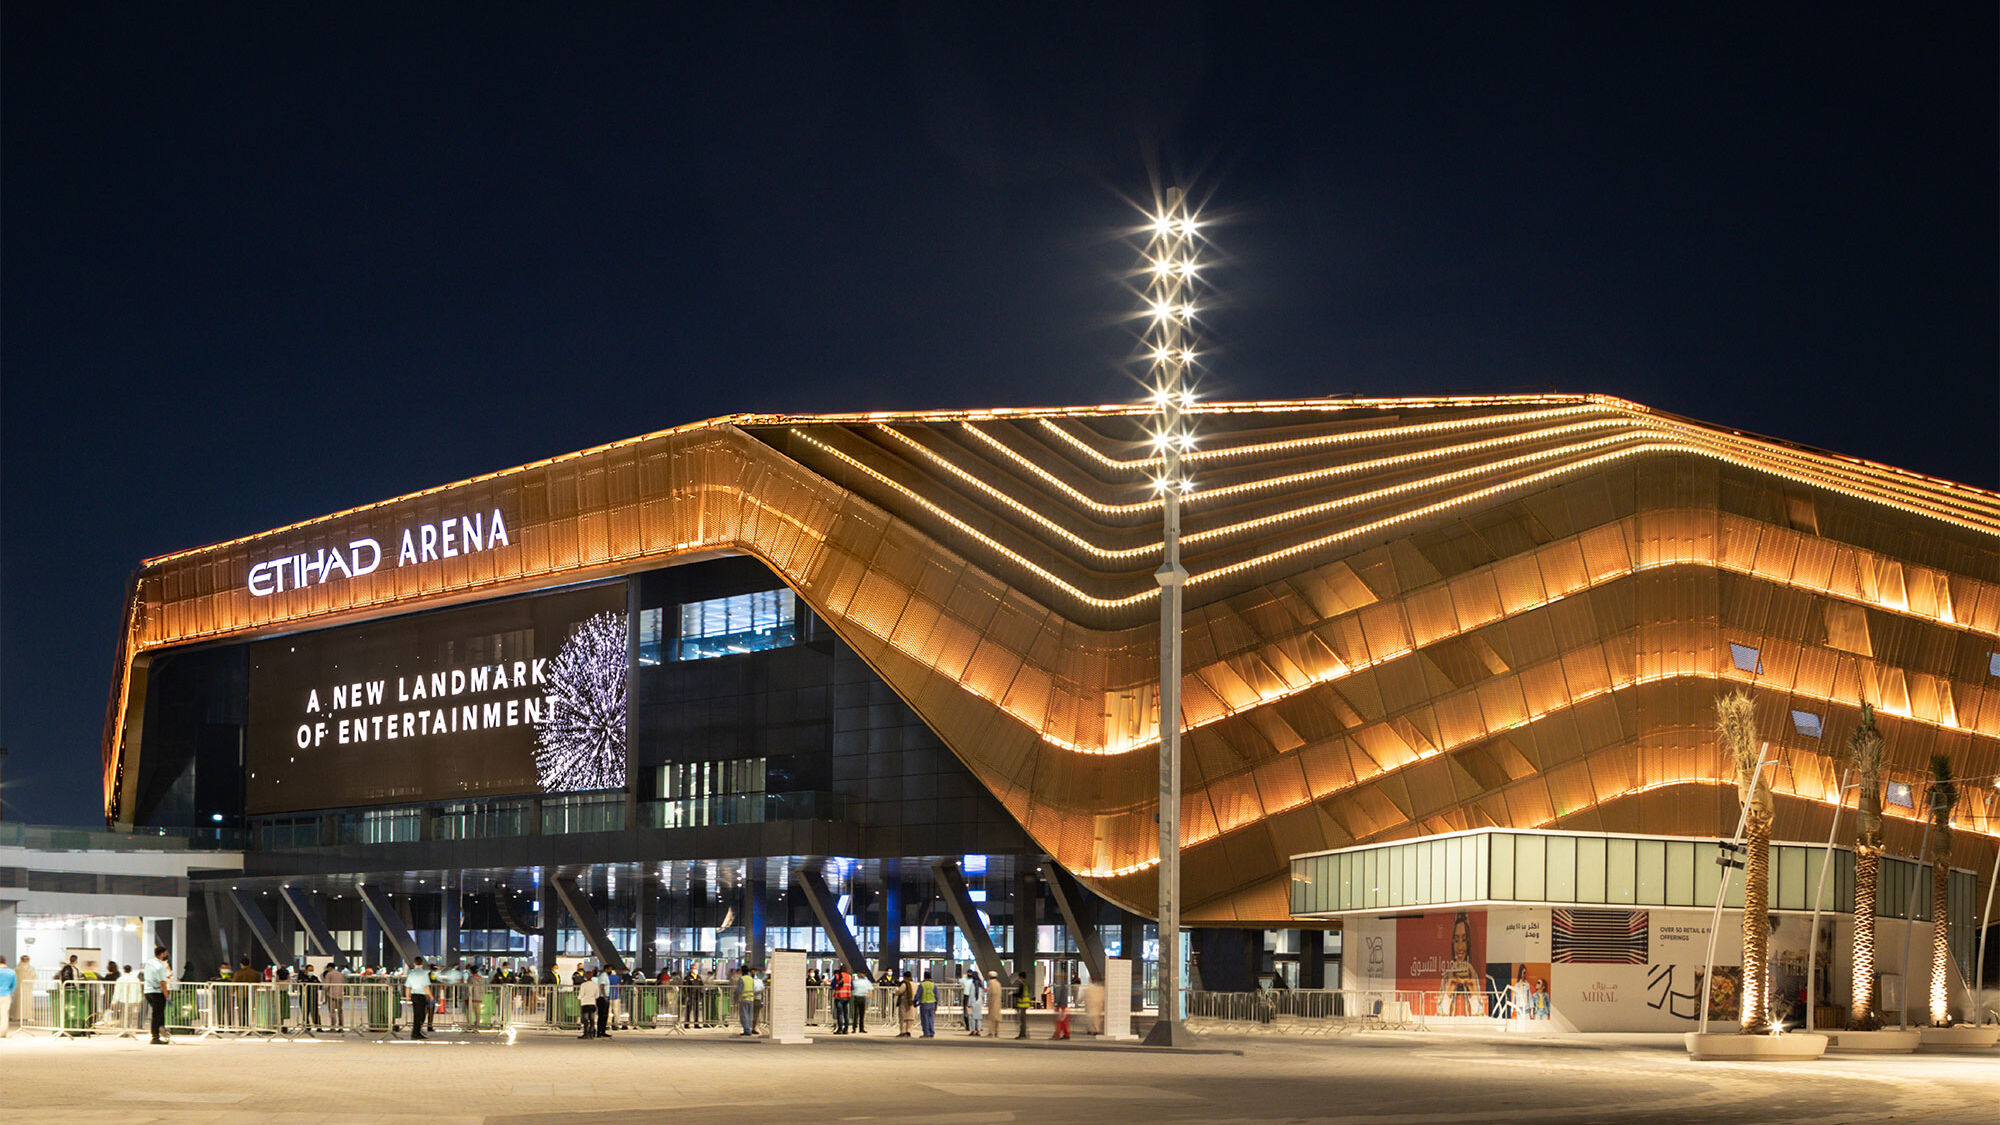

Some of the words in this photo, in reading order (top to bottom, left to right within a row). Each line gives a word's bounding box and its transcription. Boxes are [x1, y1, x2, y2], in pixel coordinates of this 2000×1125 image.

[248, 538, 381, 597] ETIHAD
[398, 508, 509, 568] ARENA
[306, 689, 320, 714] A
[333, 680, 385, 710] NEW
[398, 657, 548, 703] LANDMARK
[297, 722, 326, 749] OF
[338, 696, 559, 745] ENTERTAINMENT
[1582, 991, 1618, 1002] MIRAL
